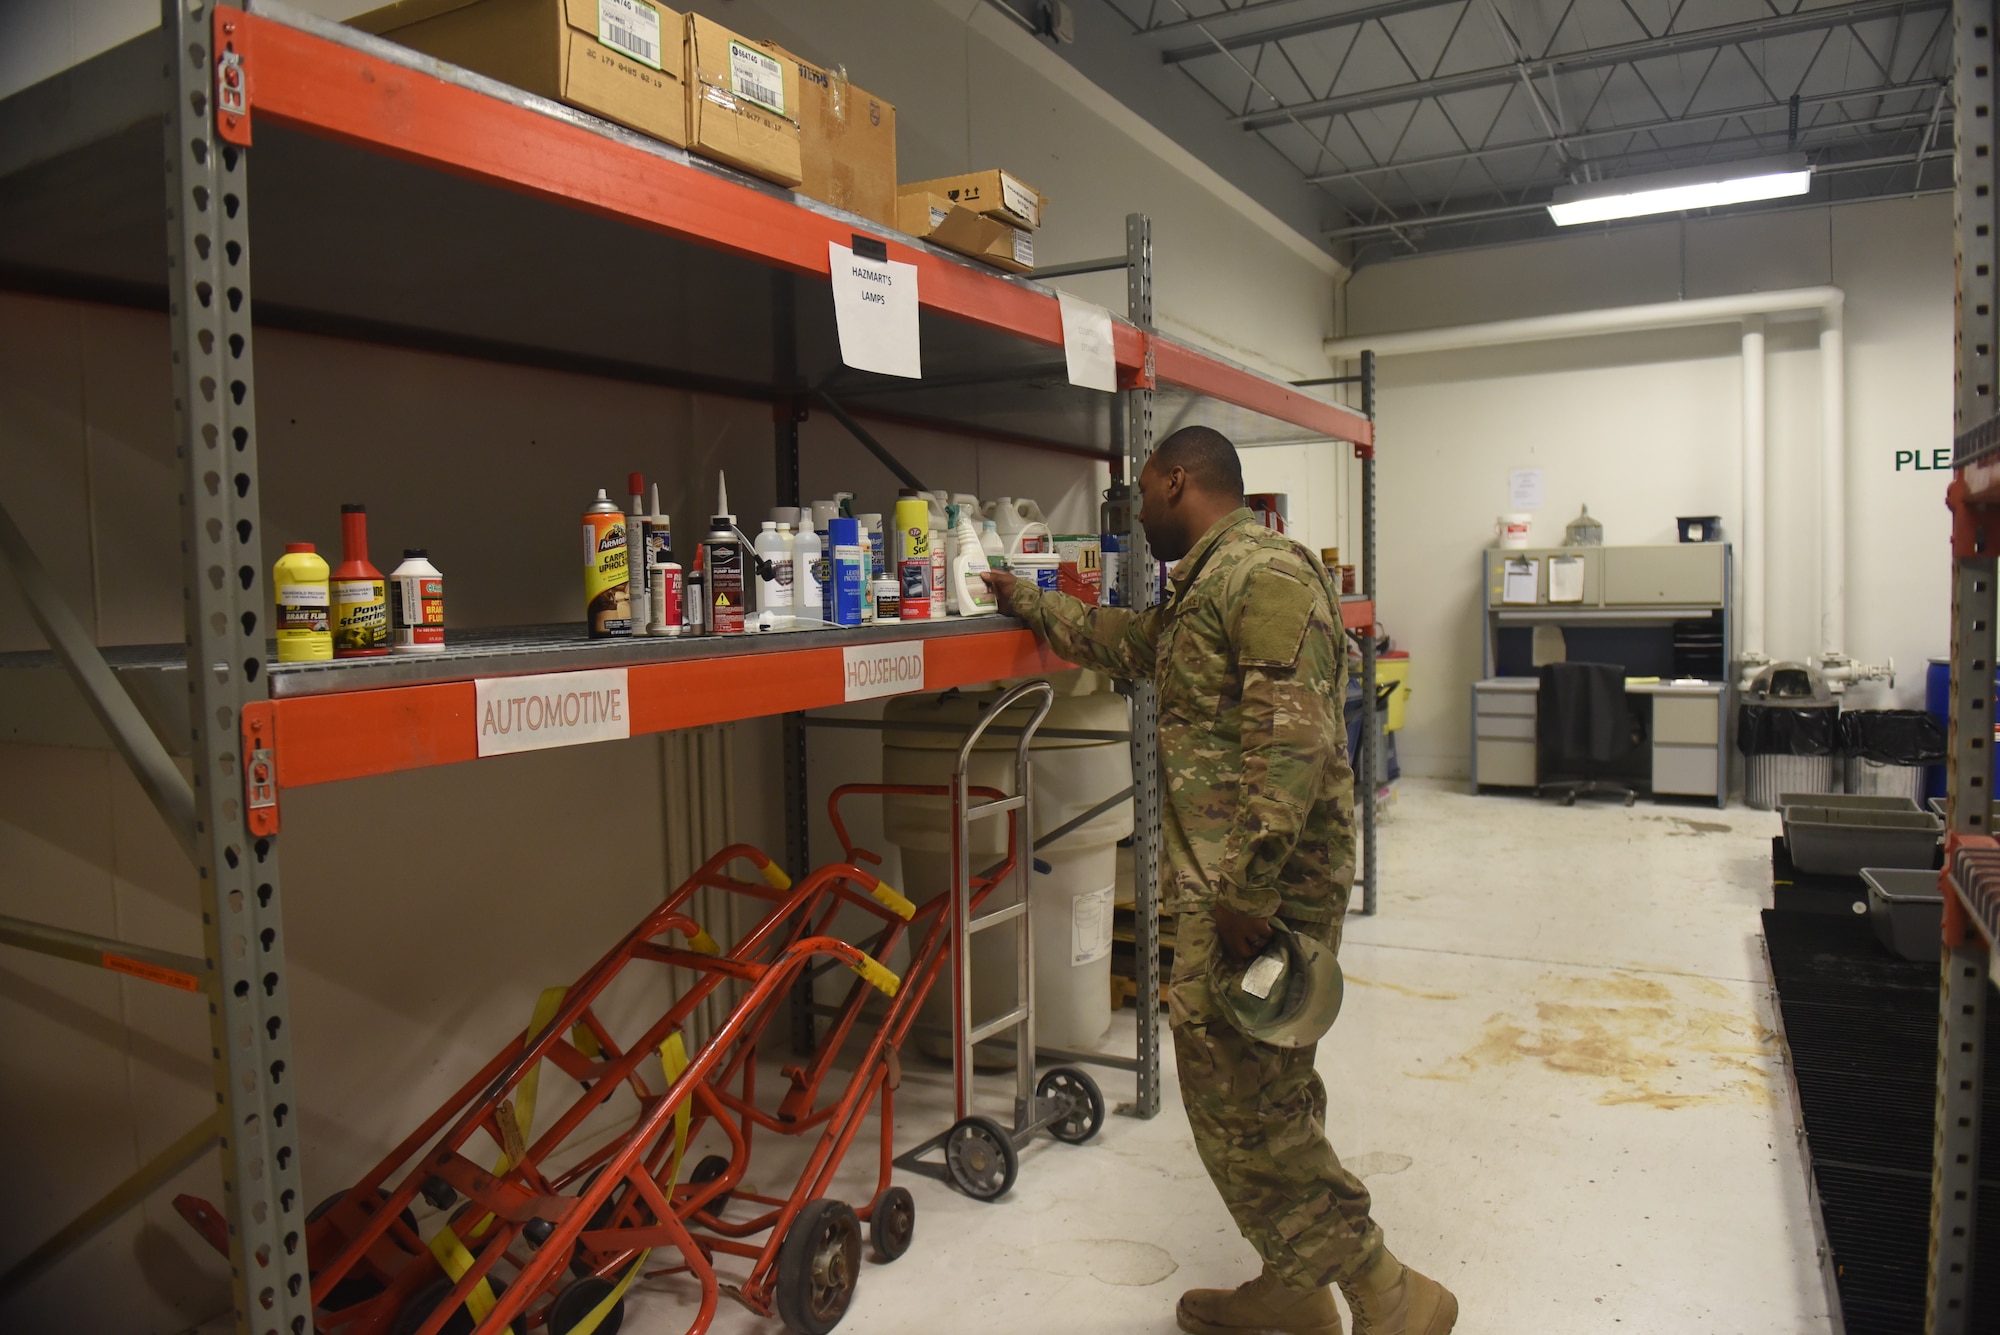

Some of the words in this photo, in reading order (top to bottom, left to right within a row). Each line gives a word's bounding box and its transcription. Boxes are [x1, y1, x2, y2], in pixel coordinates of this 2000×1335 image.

[852, 266, 892, 286] HAZMART'S
[862, 290, 885, 304] LAMPS
[310, 612, 327, 620] FLUID
[847, 655, 922, 688] HOUSEHOLD
[482, 688, 621, 736] AUTOMOTIVE
